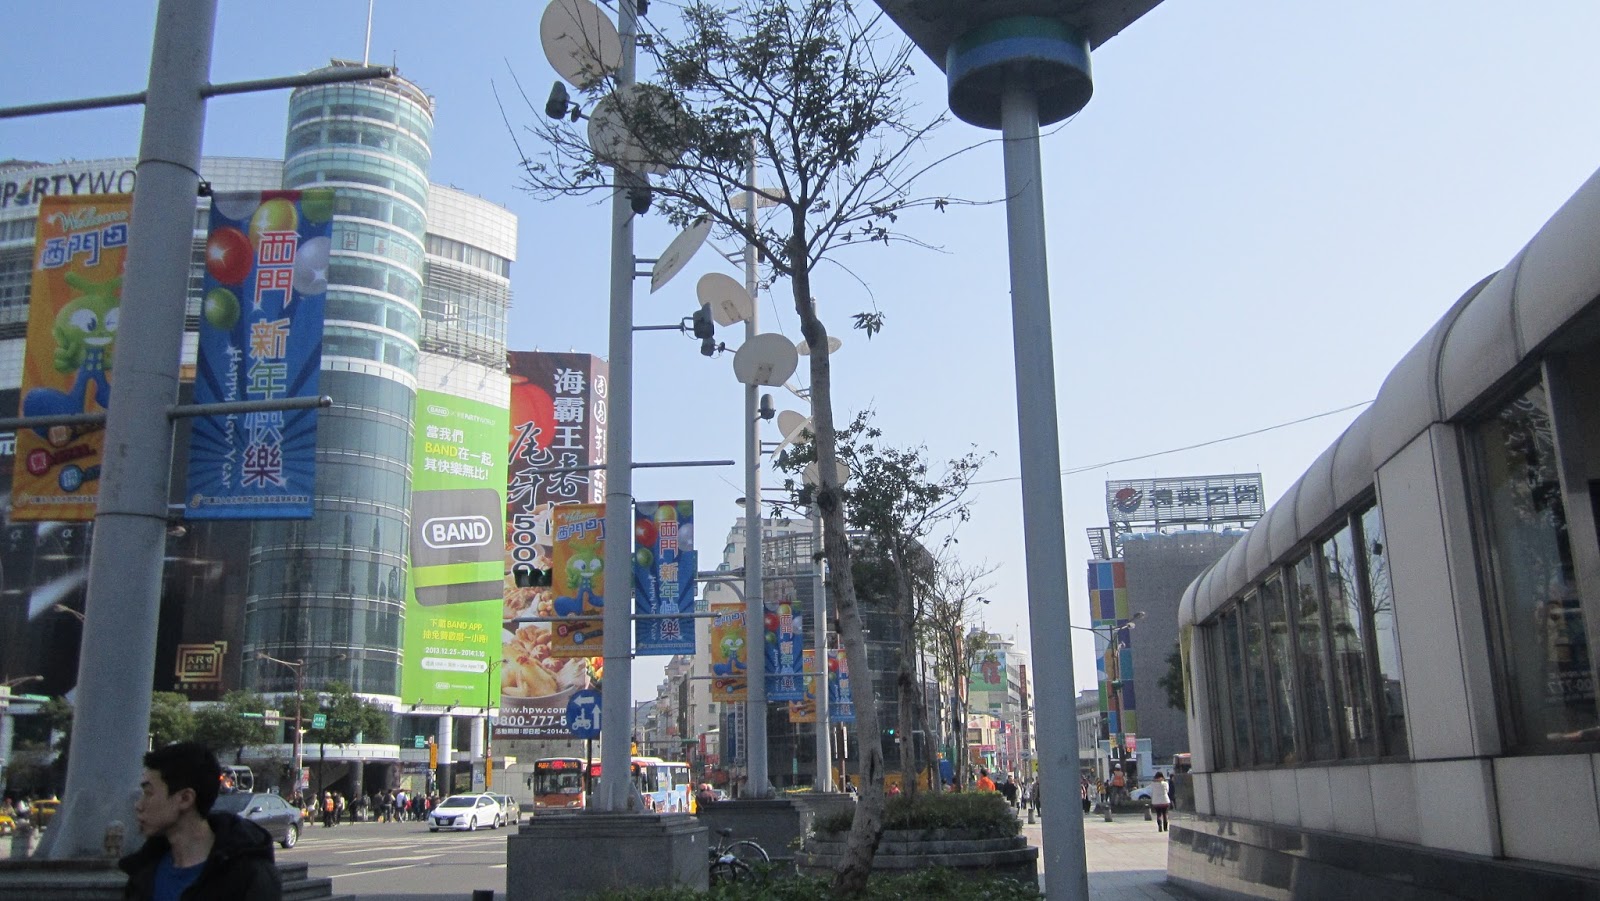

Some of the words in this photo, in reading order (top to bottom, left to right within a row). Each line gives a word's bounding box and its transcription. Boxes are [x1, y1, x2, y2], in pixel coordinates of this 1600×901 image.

[255, 231, 300, 309] 西門
[426, 425, 464, 444] 當我們
[552, 367, 586, 450] 海霸王
[507, 421, 555, 513] 尾牙
[432, 521, 486, 542] BAND
[659, 520, 680, 560] 西門
